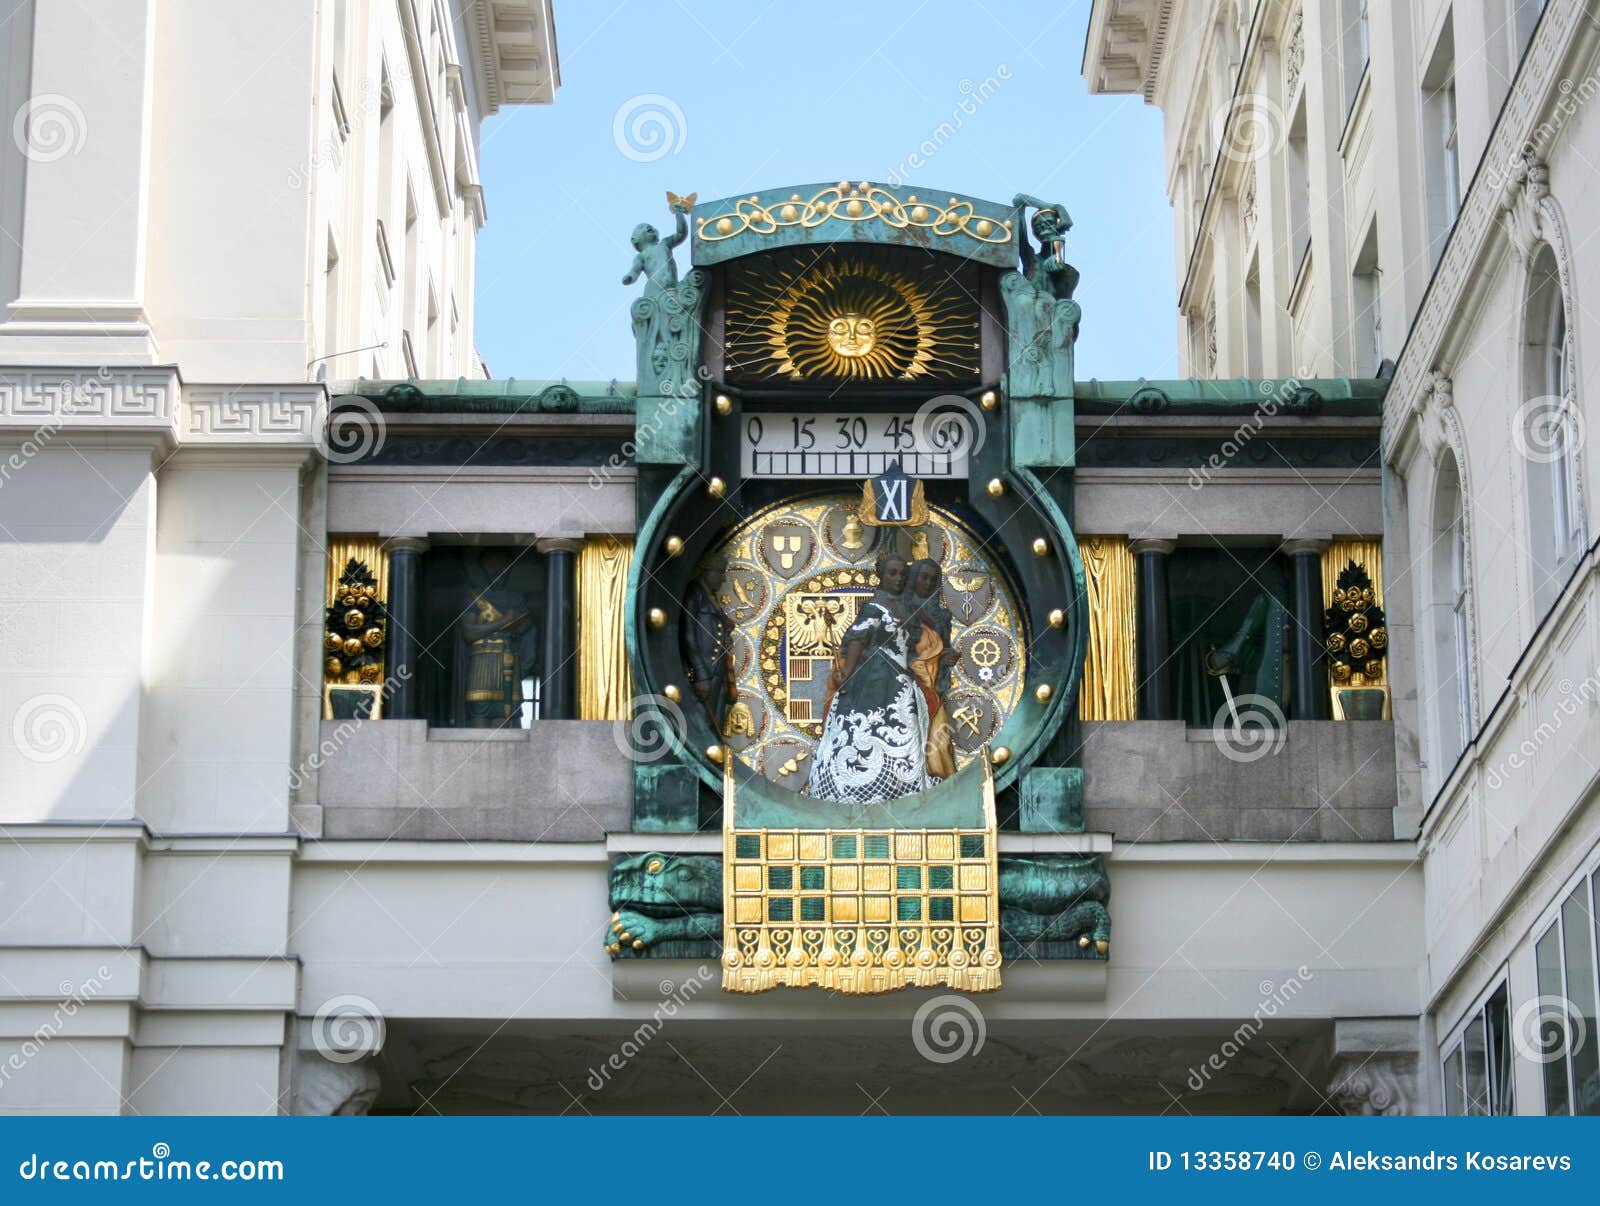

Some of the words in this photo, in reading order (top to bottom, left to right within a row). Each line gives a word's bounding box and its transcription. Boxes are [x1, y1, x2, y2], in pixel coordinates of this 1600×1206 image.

[747, 416, 763, 447] 0
[792, 417, 816, 449] 15
[835, 417, 867, 449] 30
[884, 417, 915, 449] 45
[880, 480, 908, 521] XI
